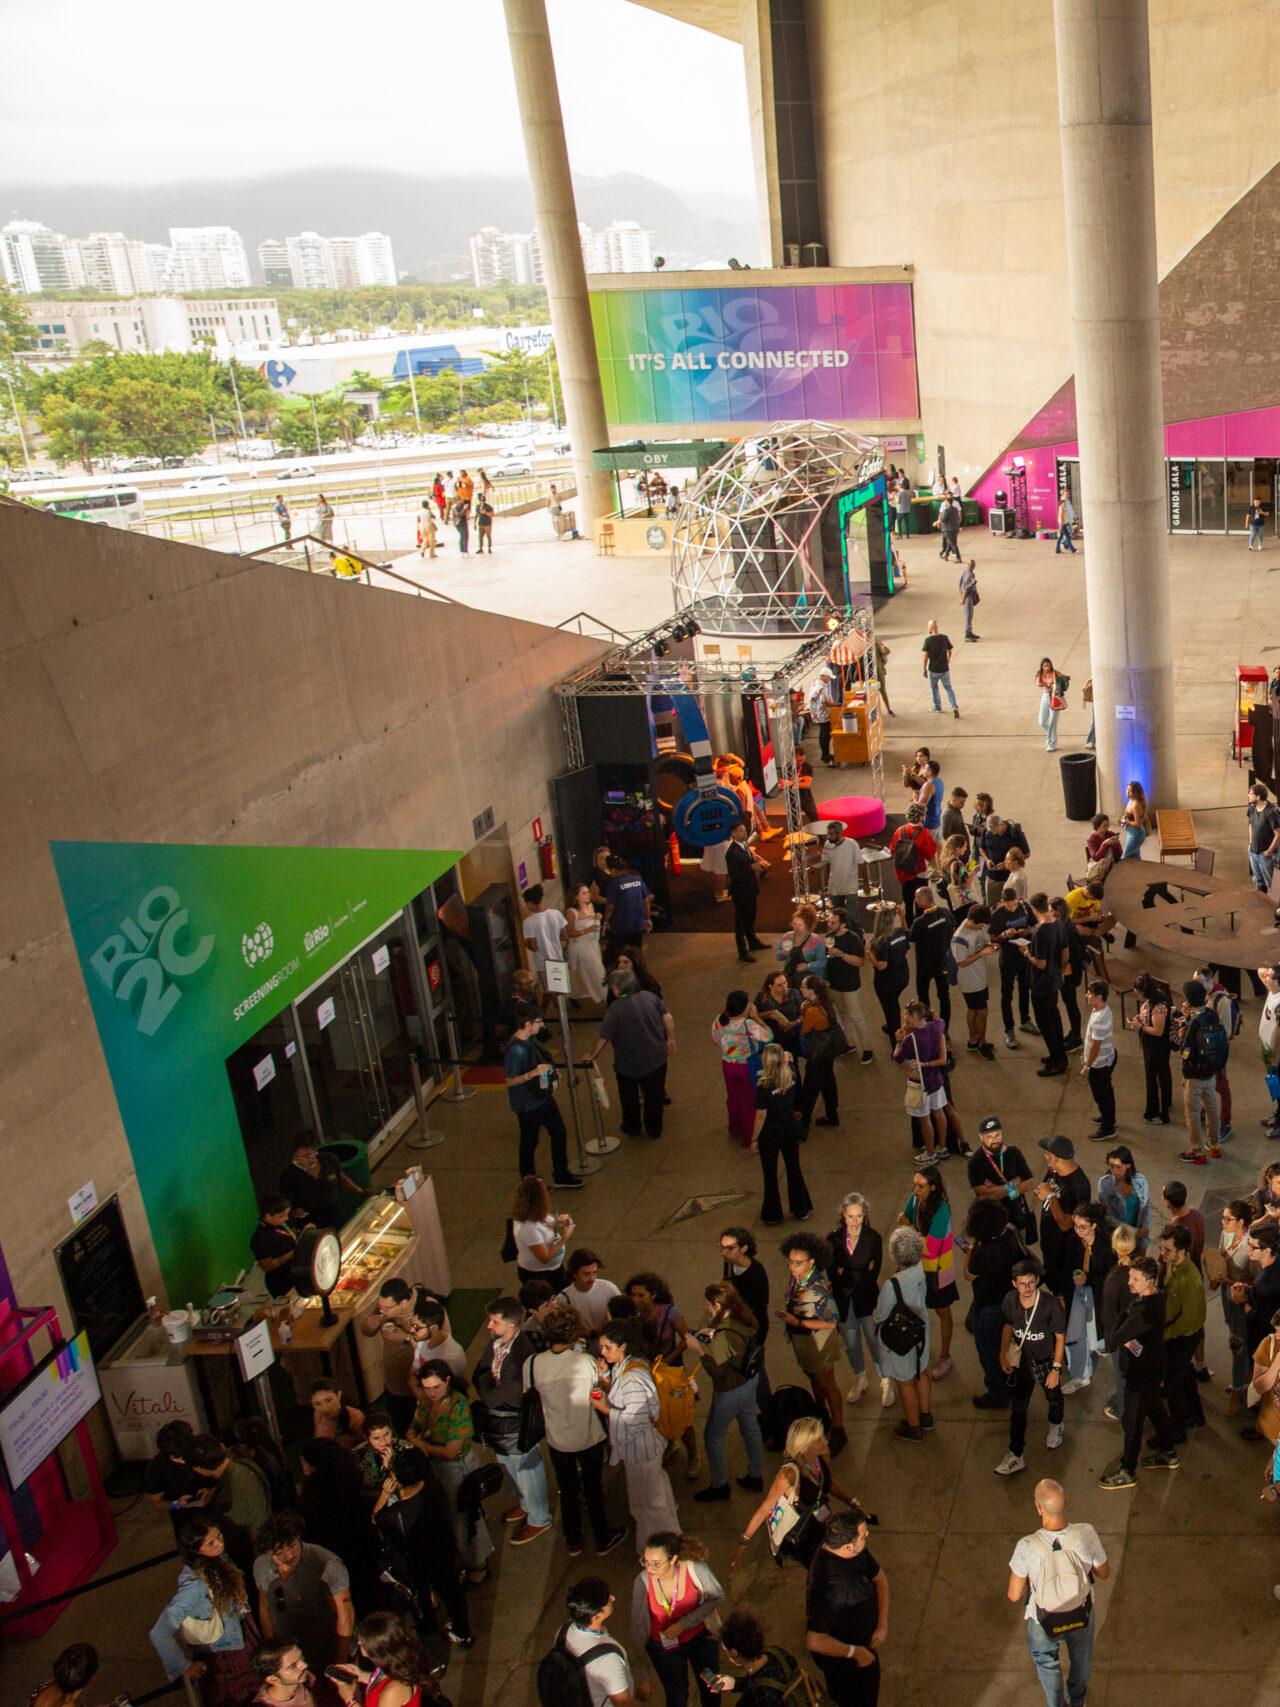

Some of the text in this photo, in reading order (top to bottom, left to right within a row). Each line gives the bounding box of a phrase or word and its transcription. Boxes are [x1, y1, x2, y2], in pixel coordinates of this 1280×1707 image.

[628, 350, 849, 371] IT'S ALL CONNECTED
[643, 454, 669, 464] OBY
[1171, 465, 1180, 526] GRANDE SALA
[233, 975, 279, 1021] SCREENING
[111, 1391, 185, 1416] Vitali
